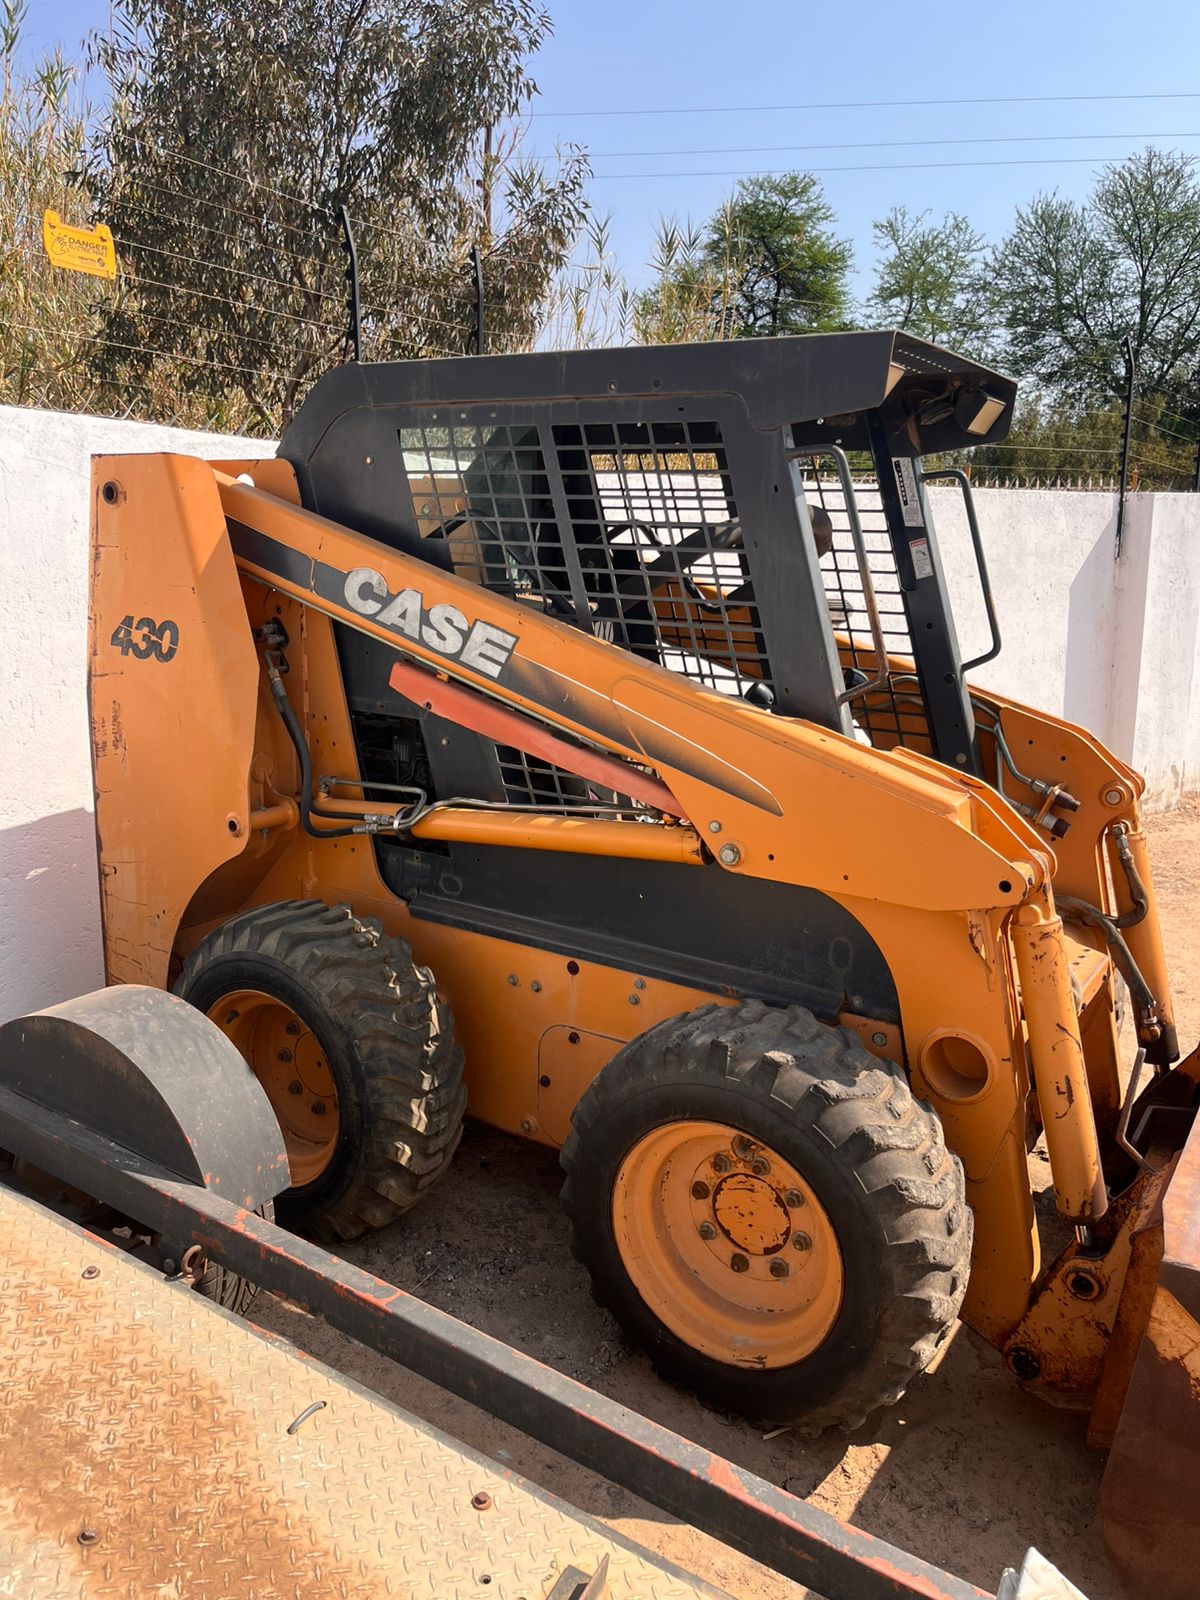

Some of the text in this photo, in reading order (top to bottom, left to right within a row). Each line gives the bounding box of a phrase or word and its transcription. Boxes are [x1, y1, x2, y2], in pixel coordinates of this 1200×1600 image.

[69, 237, 108, 251] DANGER
[110, 615, 179, 664] 430
[344, 567, 518, 679] CASE
